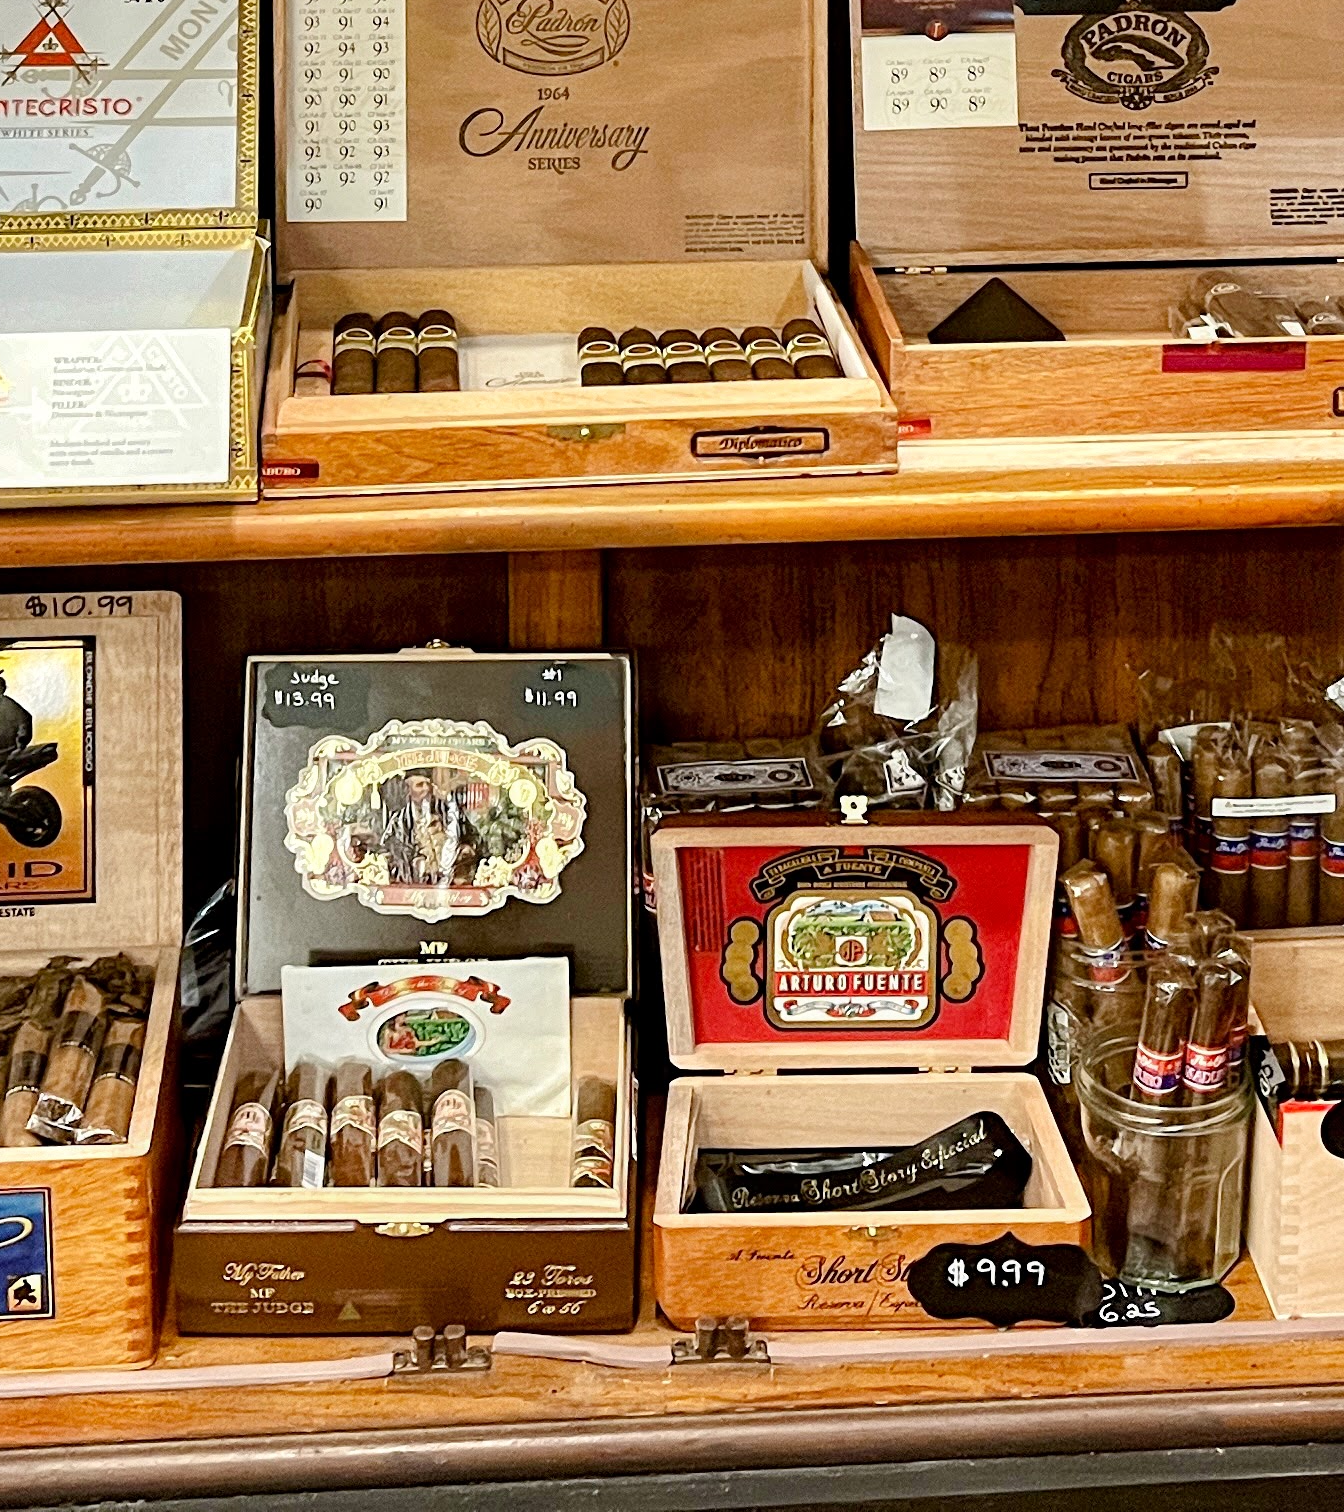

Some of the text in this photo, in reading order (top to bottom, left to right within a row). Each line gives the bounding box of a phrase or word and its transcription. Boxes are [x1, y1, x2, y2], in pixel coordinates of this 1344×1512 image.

[1081, 14, 1188, 50] PADRÓN
[891, 65, 985, 84] 89 89 89
[1106, 71, 1164, 85] CIGARS
[536, 87, 570, 101] 1964
[458, 105, 650, 172] Anniversary
[528, 155, 581, 175] SERIES
[718, 434, 803, 453] Diplomatico
[25, 595, 134, 619] $10.99
[274, 690, 336, 710] $13.99
[523, 687, 578, 708] $11.99
[835, 862, 882, 874] FUENTE
[778, 973, 924, 992] ARTURO FUENTE
[800, 1176, 860, 1205] Short
[859, 1160, 919, 1195] Story
[919, 1118, 989, 1174] Especial
[254, 1261, 306, 1282] Father
[795, 1253, 880, 1289] Short
[211, 1301, 315, 1315] THE JUDGE
[1099, 1302, 1161, 1323] 6.25
